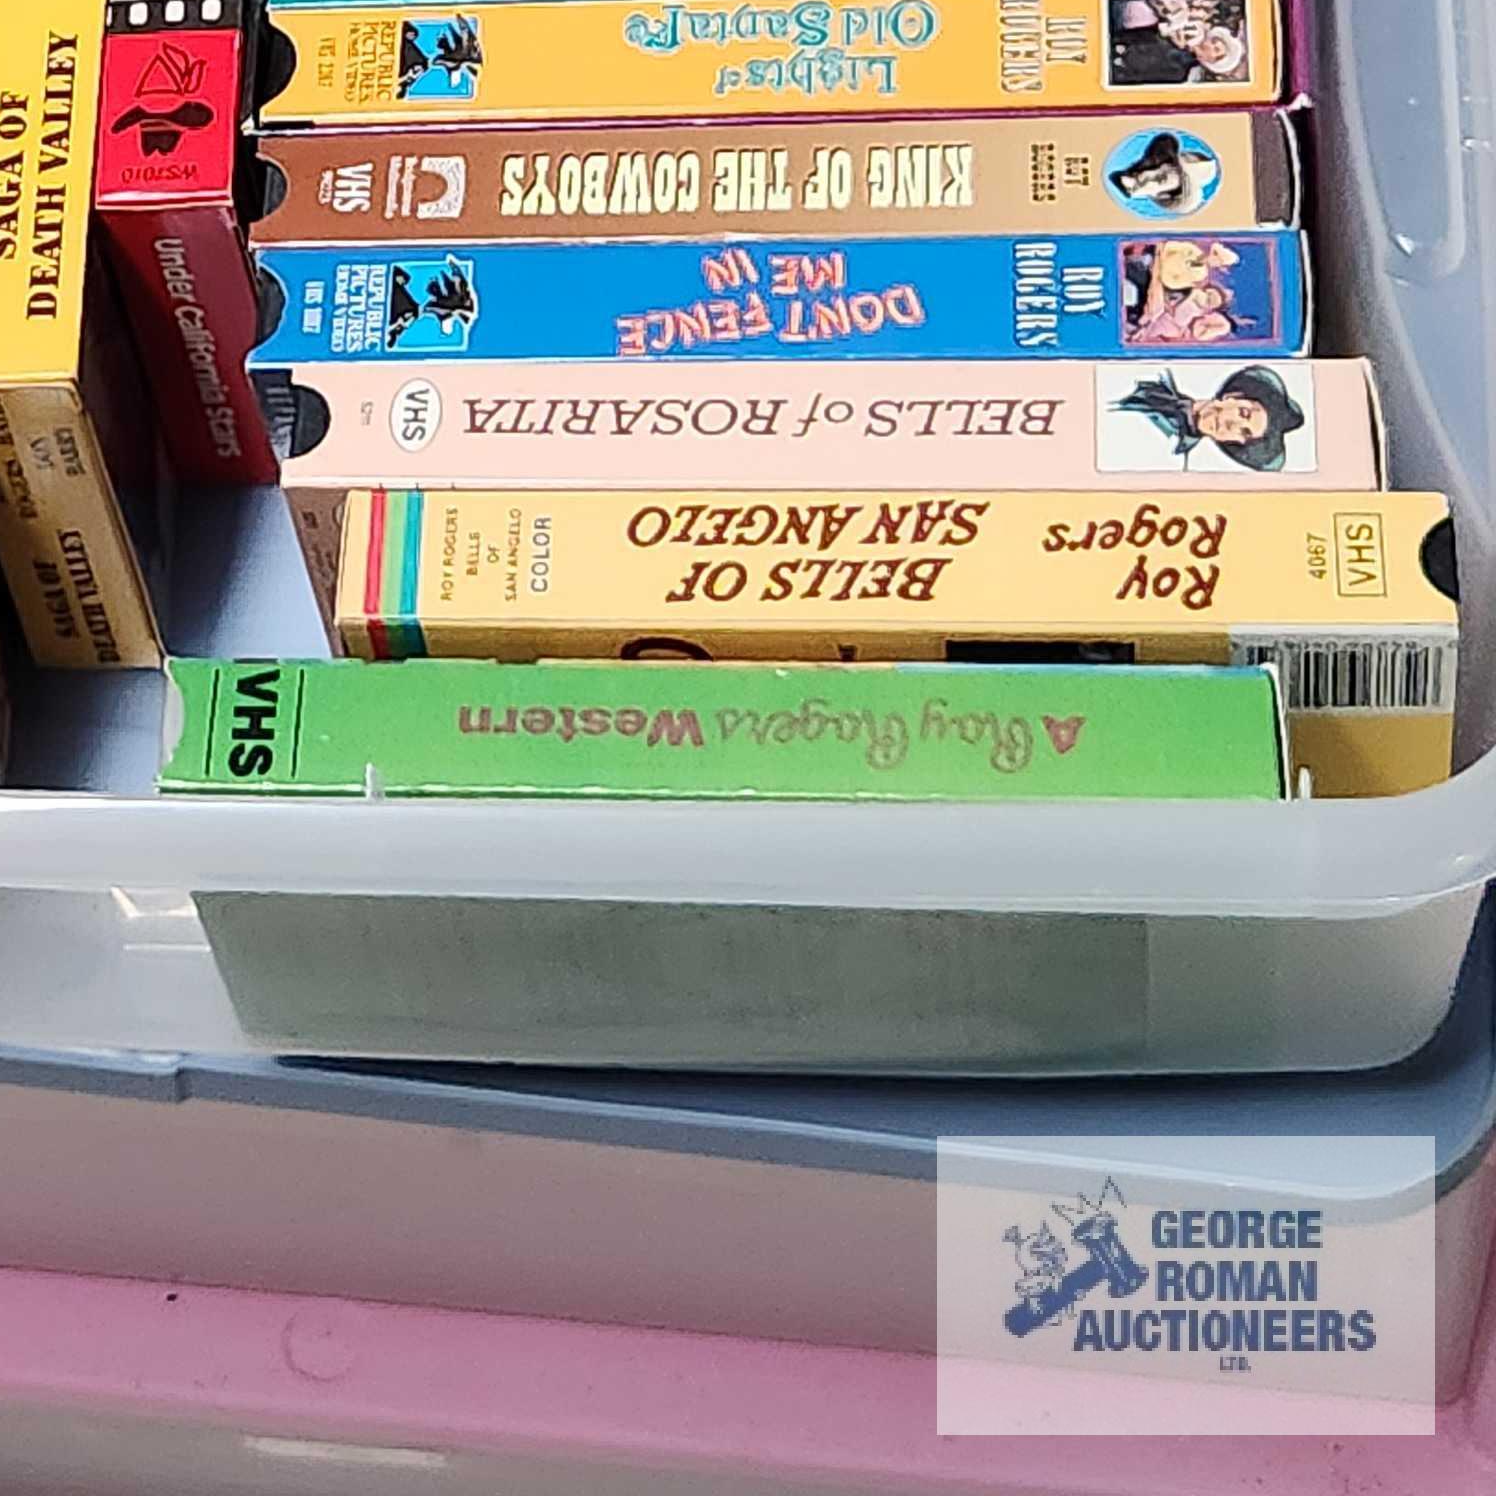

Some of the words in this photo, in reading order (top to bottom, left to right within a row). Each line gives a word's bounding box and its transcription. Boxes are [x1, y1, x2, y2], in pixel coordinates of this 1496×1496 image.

[1044, 15, 1088, 64] ROY
[745, 48, 900, 96] Lights
[37, 31, 80, 176] VALLEY
[331, 162, 375, 214] VHS
[498, 151, 701, 217] COWBOYS
[713, 148, 793, 213] THE
[803, 147, 853, 210] OF
[869, 144, 974, 209] KING
[26, 183, 68, 321] DEATH
[154, 237, 197, 304] Under
[701, 246, 761, 293] IN
[767, 250, 846, 296] ME
[777, 282, 927, 343] DON'T
[1013, 241, 1062, 349] ROGERS
[1061, 265, 1106, 320] ROY
[615, 291, 775, 357] FENCE
[401, 387, 431, 442] VHS
[461, 398, 788, 436] ROSARITA
[792, 392, 855, 438] of
[863, 398, 1066, 438] BELLS
[626, 504, 864, 551] ANGELO
[858, 499, 991, 546] SAN
[1041, 503, 1229, 560] Rogers
[530, 517, 552, 593] COLOR
[664, 560, 749, 604] OF
[759, 557, 954, 603] BELLS
[1115, 554, 1221, 611] Roy
[1306, 533, 1328, 581] 4067
[1344, 522, 1377, 588] VHS
[440, 570, 455, 602] ROY
[504, 571, 518, 602] SAN
[228, 668, 282, 778] VHS
[458, 705, 705, 749] Western
[715, 696, 910, 771] Rogers
[919, 697, 1035, 773] Roy
[1041, 714, 1086, 754] A
